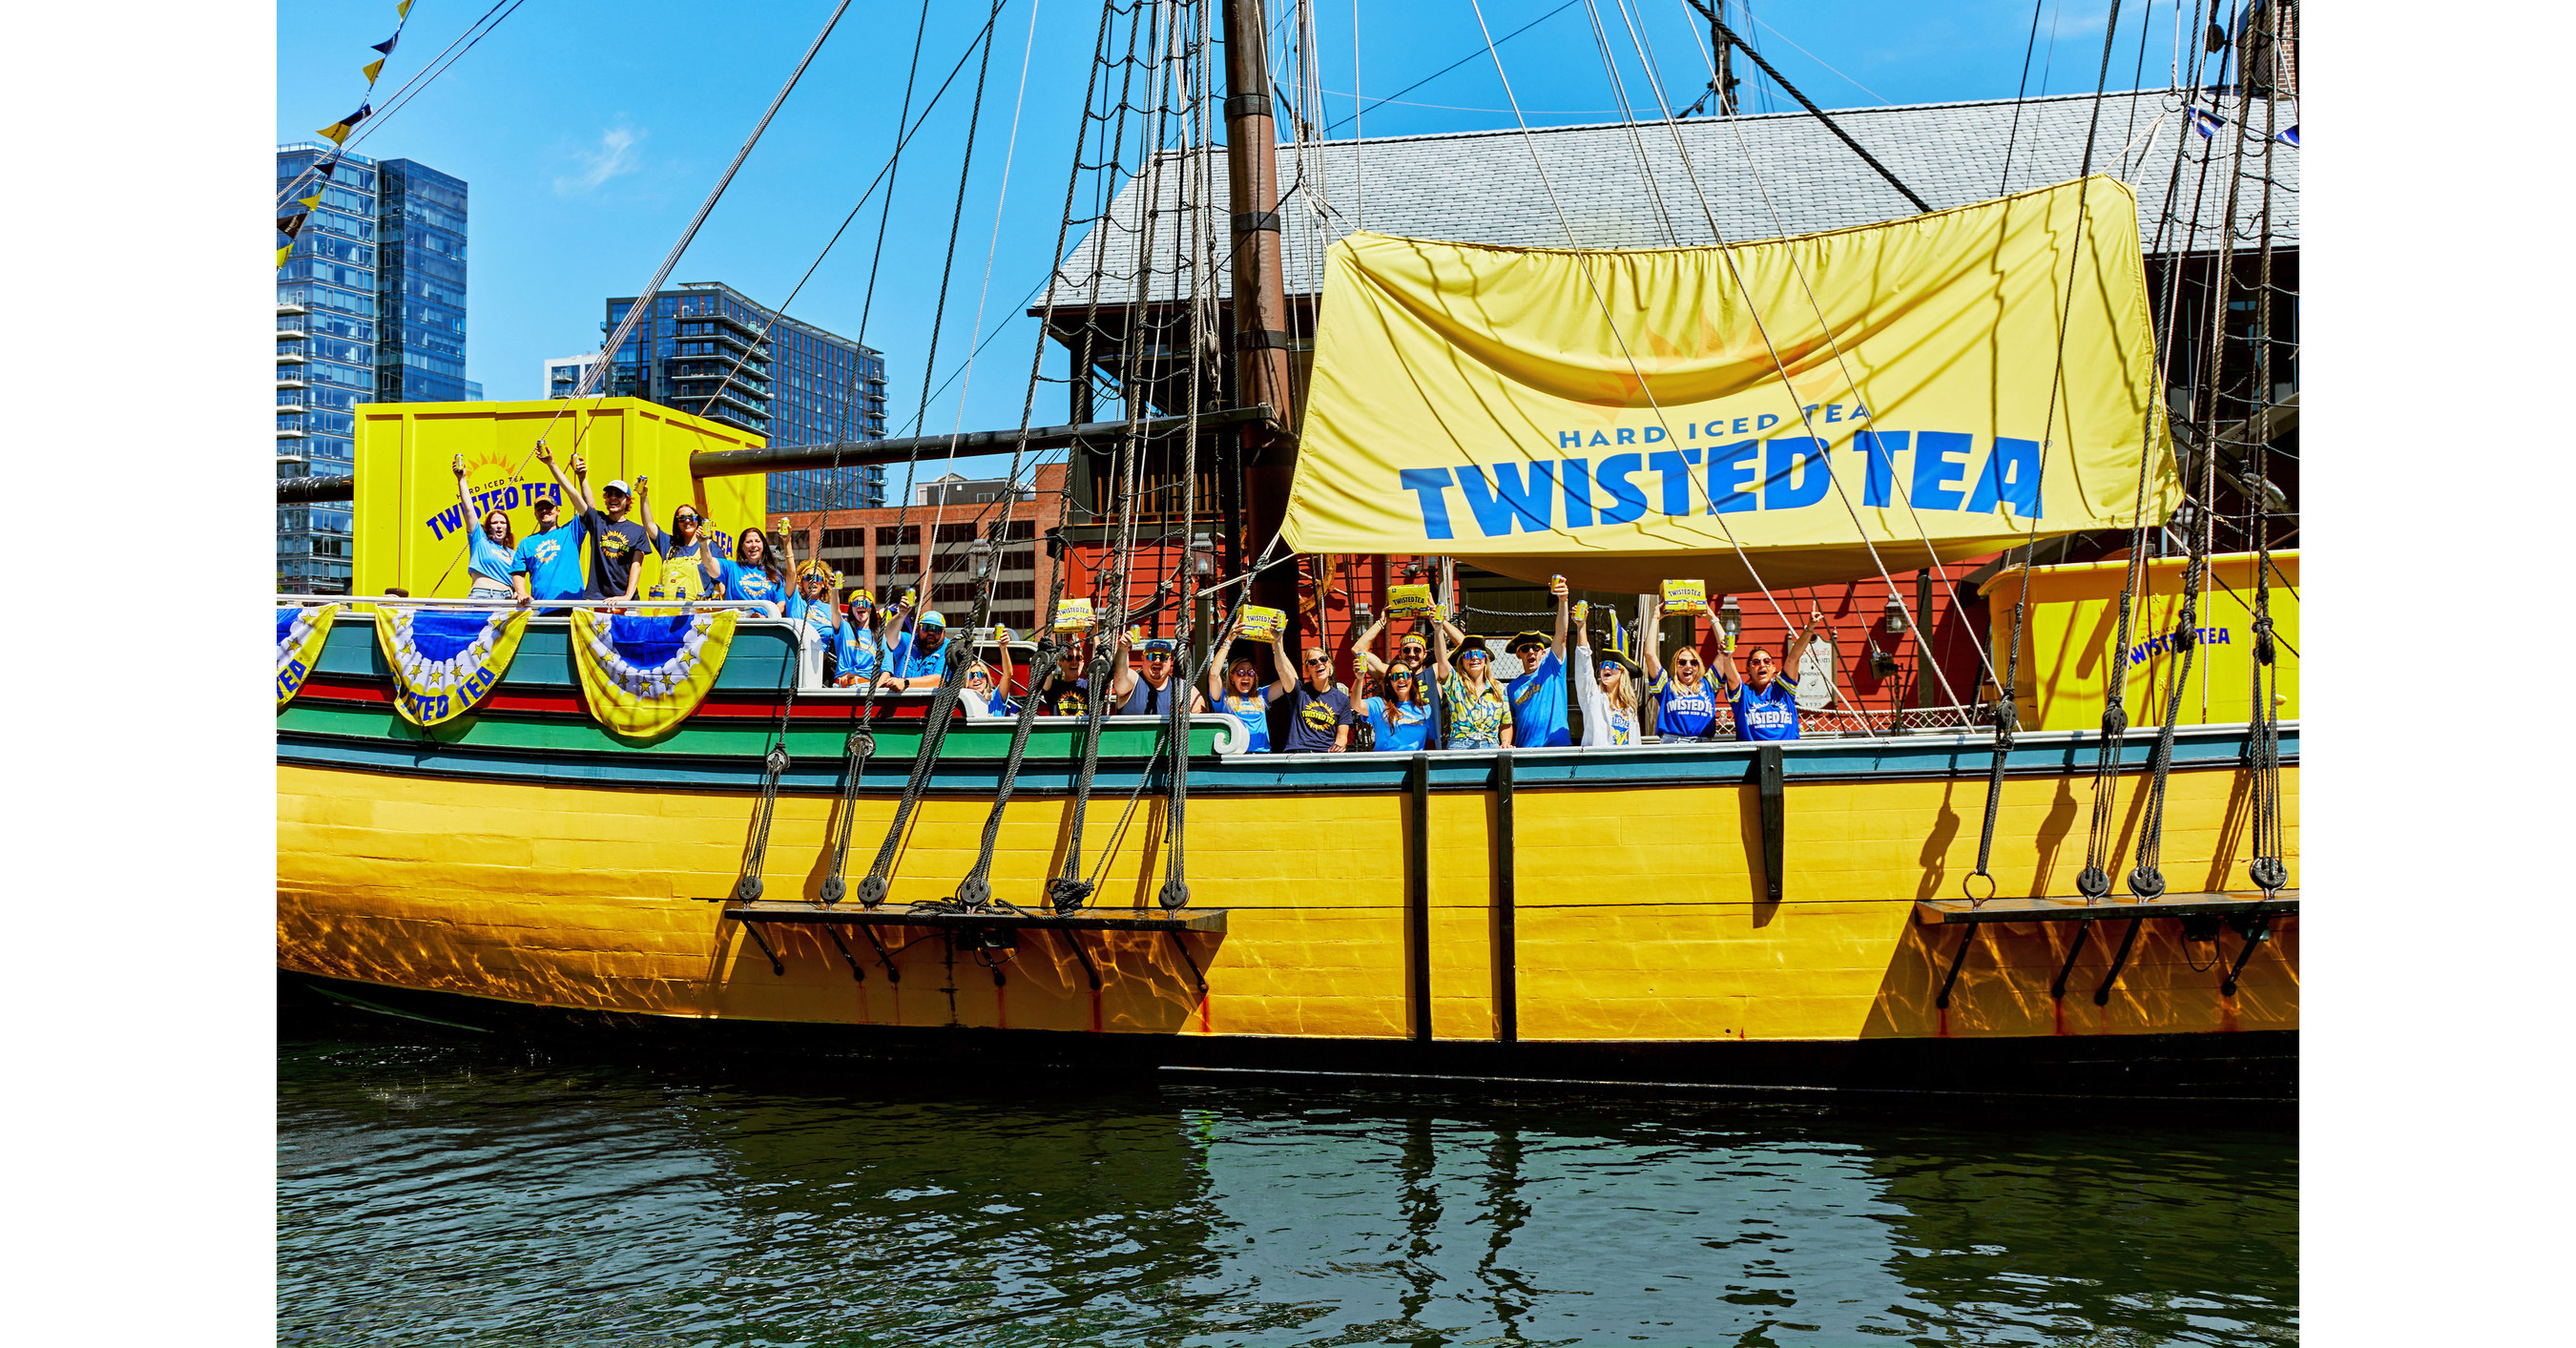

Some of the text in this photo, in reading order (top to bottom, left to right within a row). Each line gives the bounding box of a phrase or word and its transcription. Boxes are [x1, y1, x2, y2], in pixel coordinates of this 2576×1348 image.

[1558, 401, 1872, 448] HARD ICED TEA
[456, 475, 525, 500] HRD ICED TEA
[522, 482, 563, 507] TEA
[1399, 429, 2044, 540] TWISTED TEA
[715, 529, 733, 558] TEA
[1393, 596, 1424, 606] TWISTED TEA
[1668, 589, 1701, 597] TWISTED TEA
[1246, 614, 1268, 623] TWISTED
[2195, 627, 2231, 645] TEA
[277, 658, 306, 700] TEA
[456, 665, 496, 708] TEA
[1666, 698, 1704, 714] TWISTED
[1301, 710, 1336, 726] TWISTED TEA
[1745, 711, 1779, 726] WISTED
